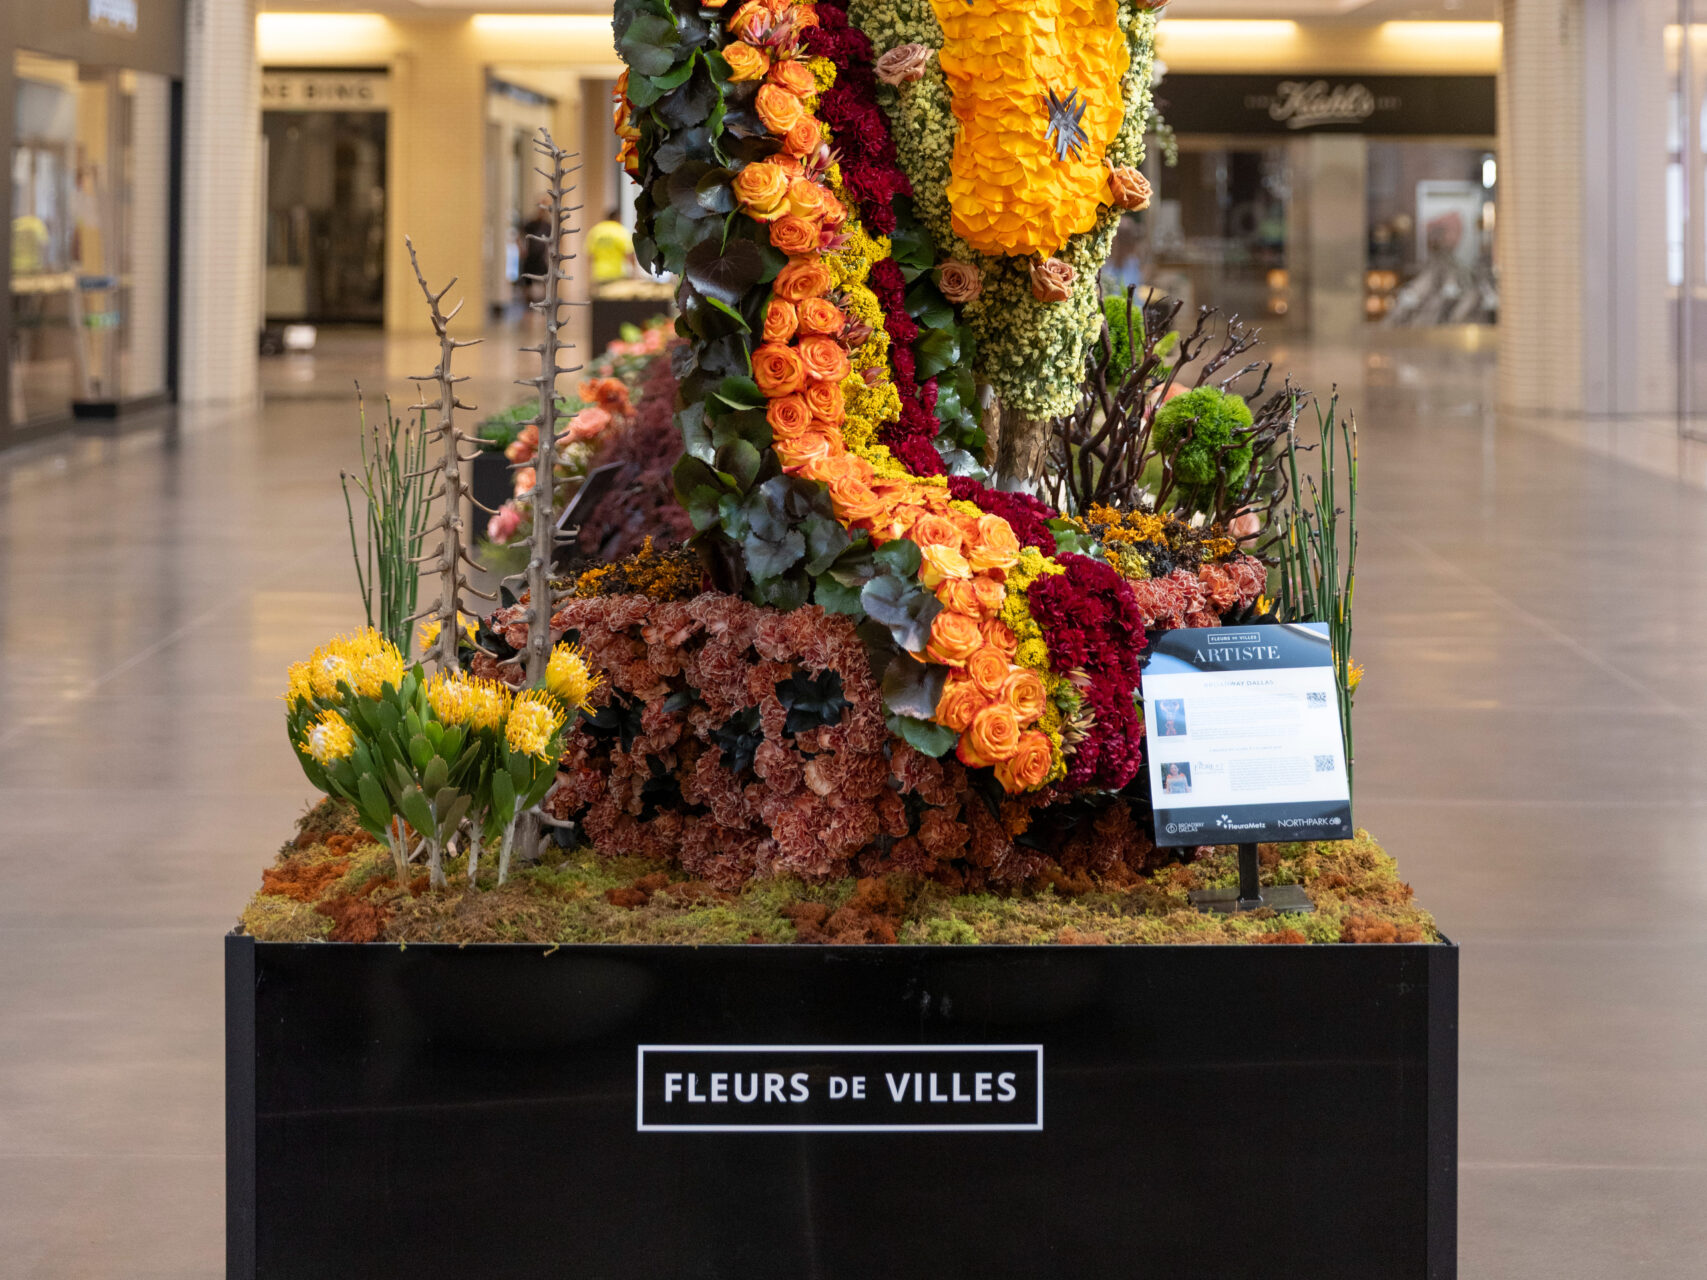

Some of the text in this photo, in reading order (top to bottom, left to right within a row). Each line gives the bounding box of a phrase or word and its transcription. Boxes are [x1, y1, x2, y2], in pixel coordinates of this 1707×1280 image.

[1193, 645, 1280, 663] ARTISTE
[1277, 817, 1328, 828] NORTHPARK
[664, 1071, 1017, 1103] FLEURS DE VILLES
